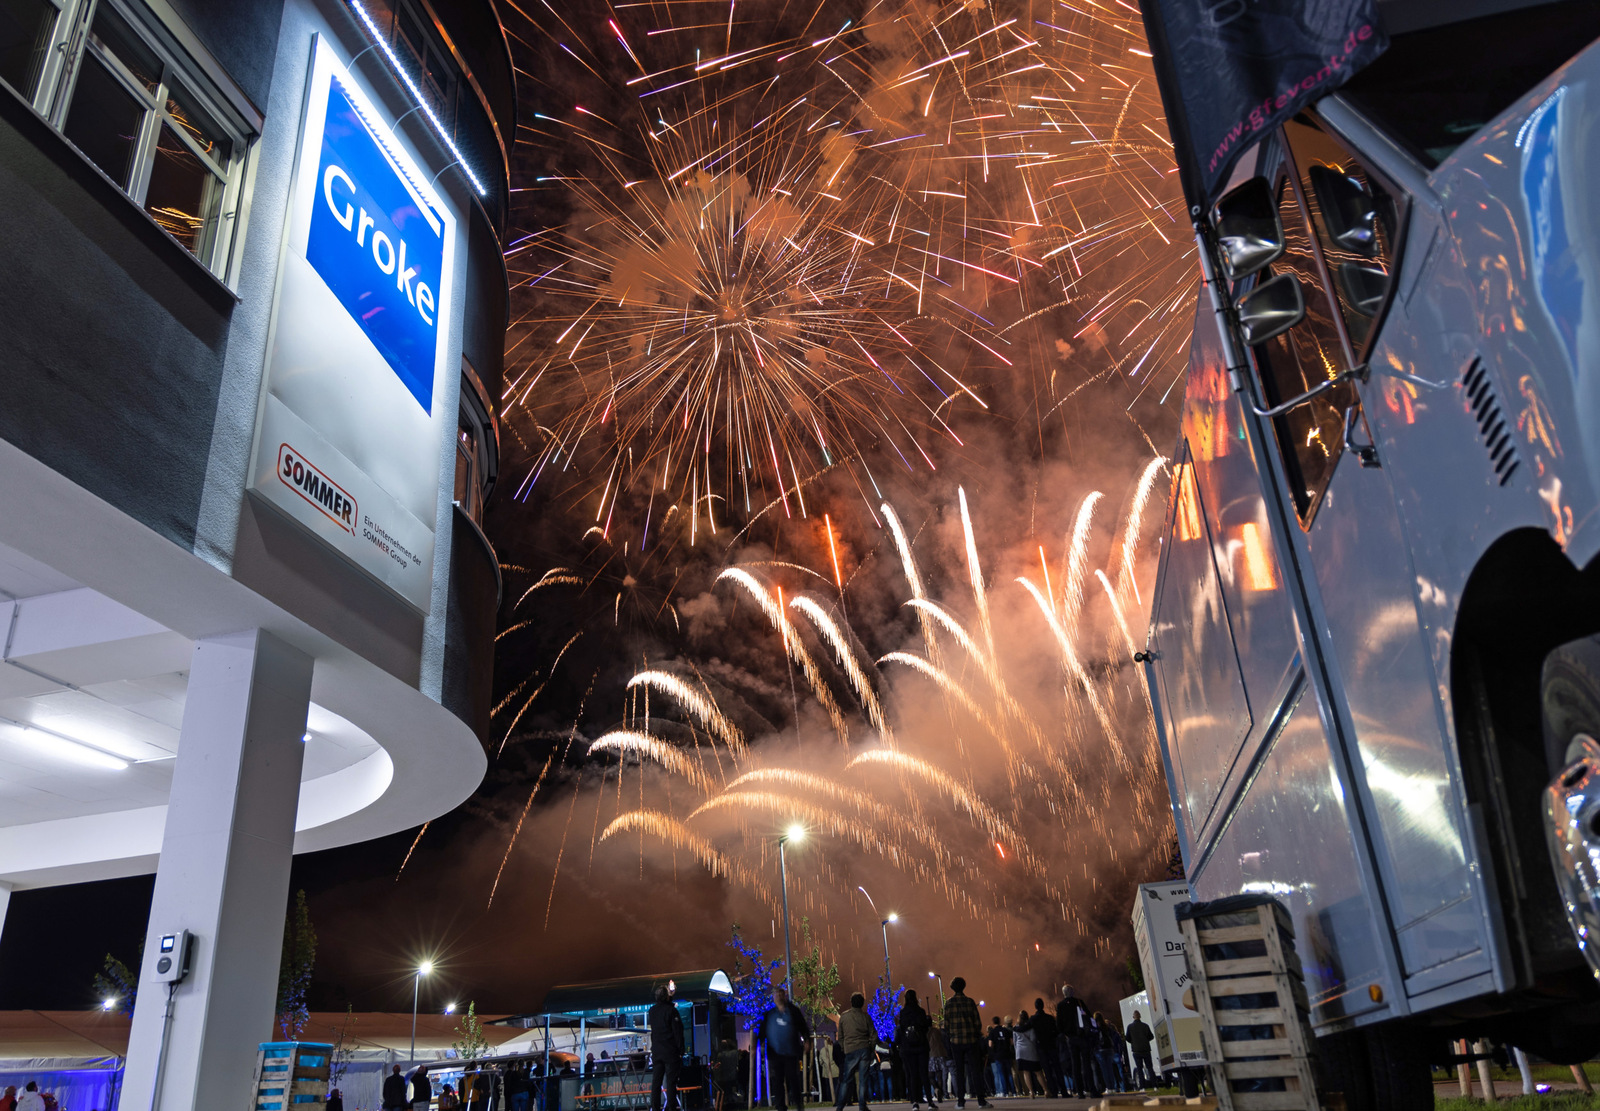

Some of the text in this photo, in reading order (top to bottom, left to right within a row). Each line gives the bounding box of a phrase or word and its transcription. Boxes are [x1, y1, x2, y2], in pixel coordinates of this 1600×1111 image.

[1208, 24, 1374, 173] www.gfevent.de
[323, 164, 435, 327] Groke
[283, 453, 353, 526] SOMMER
[363, 528, 408, 570] SOMMER Group
[364, 515, 422, 567] Ein Unternehmen der
[600, 1096, 651, 1107] UNSER BIER
